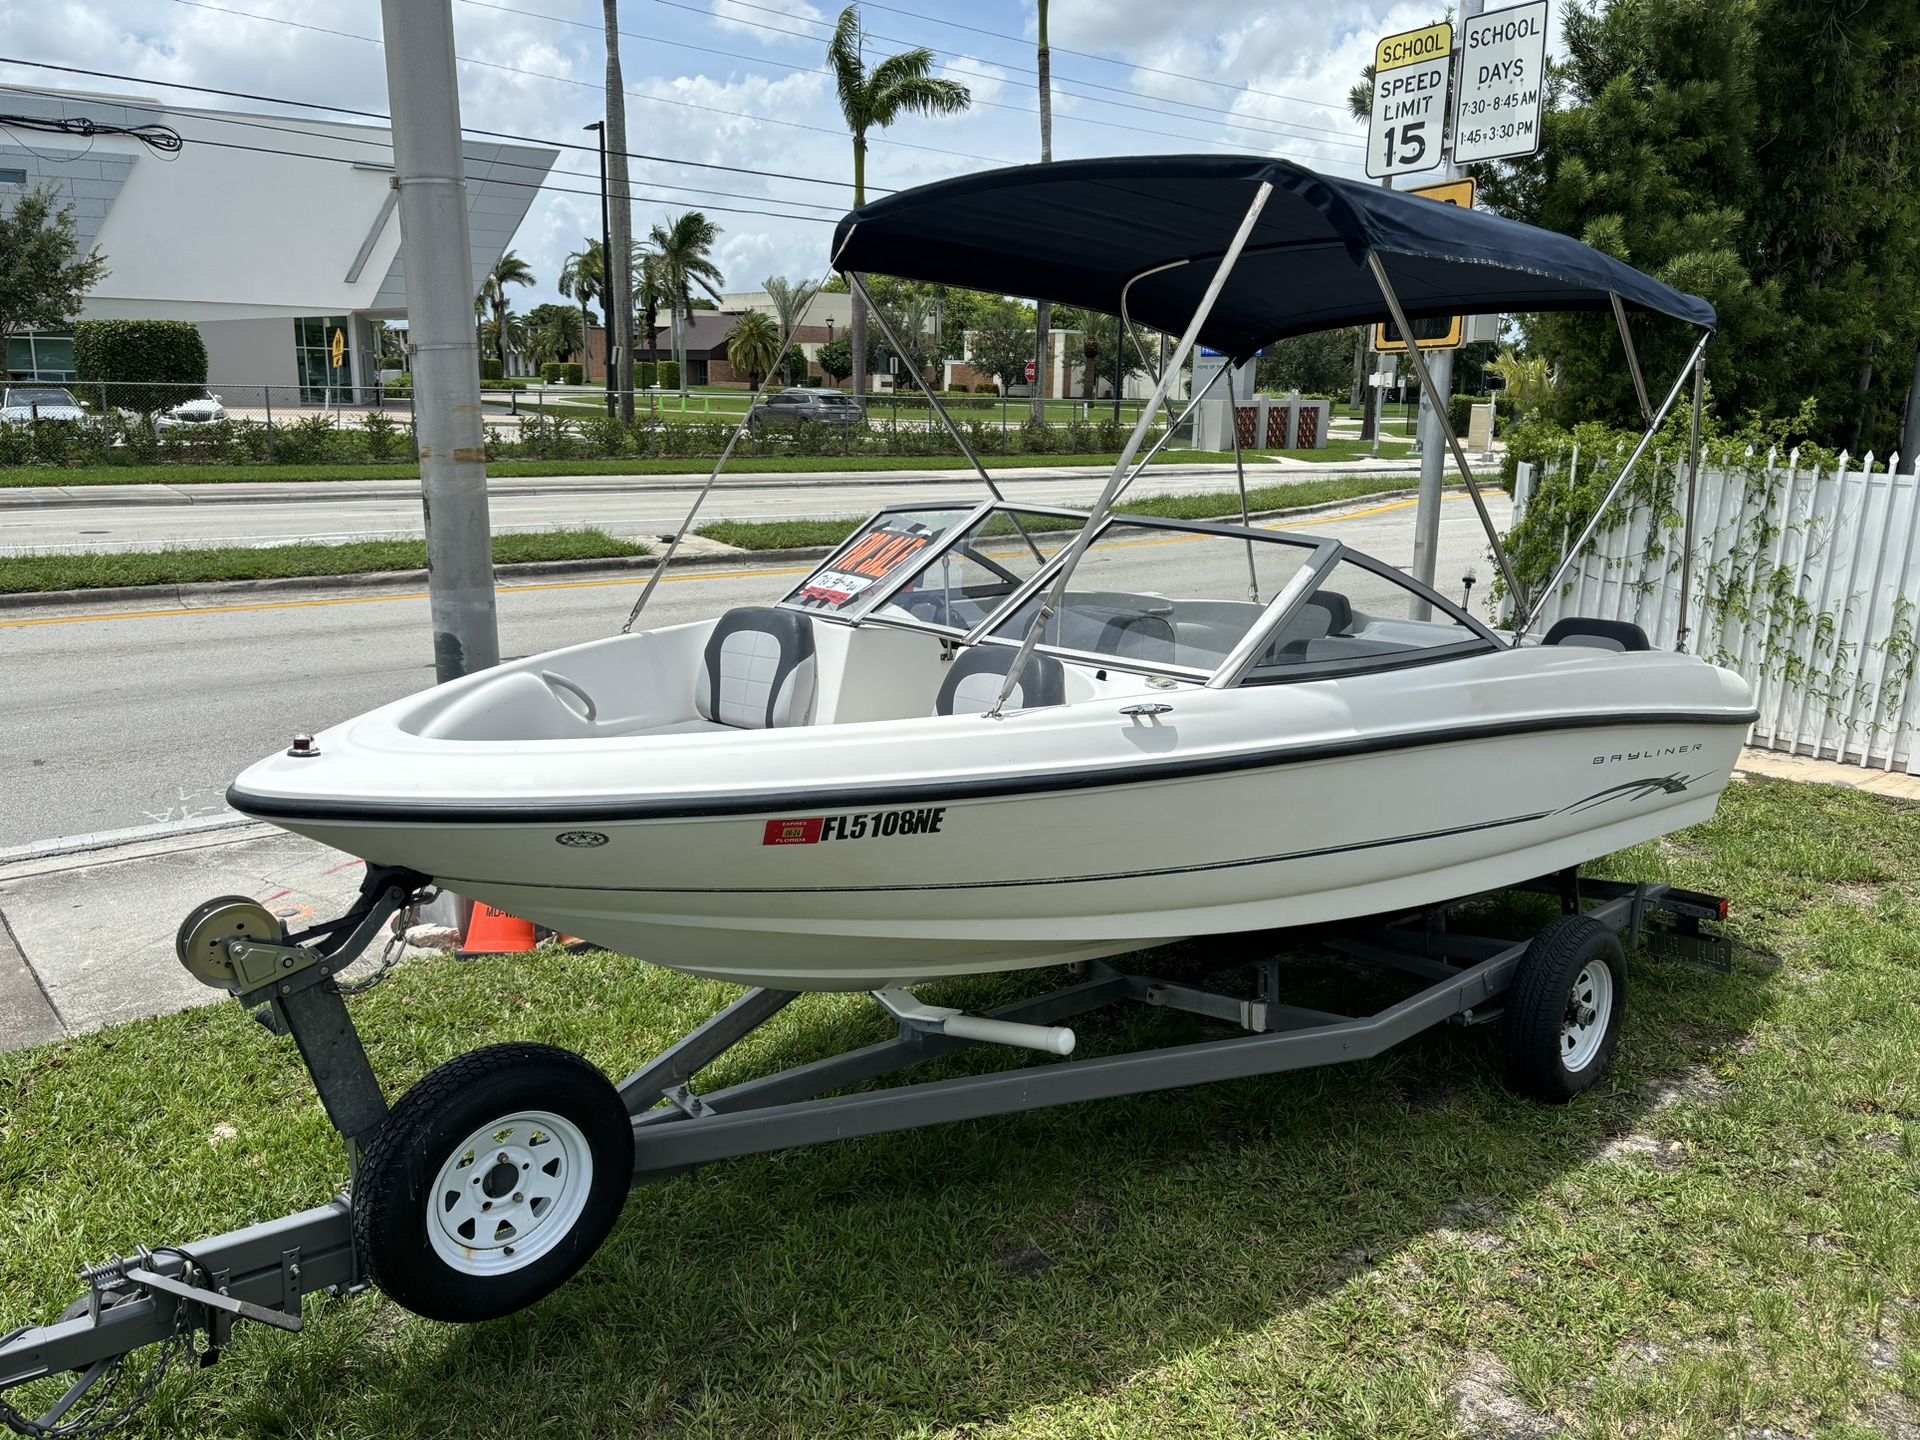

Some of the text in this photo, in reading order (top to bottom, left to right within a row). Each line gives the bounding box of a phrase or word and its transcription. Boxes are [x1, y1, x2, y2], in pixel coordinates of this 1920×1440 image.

[1469, 17, 1540, 49] SCHOOL
[1382, 33, 1444, 64] SCHOOL
[1478, 58, 1524, 84] DAYS
[1380, 70, 1442, 99] SPEED
[1520, 89, 1537, 106] AM
[1383, 95, 1433, 121] LIMIT
[1516, 120, 1533, 136] PM
[1384, 121, 1426, 168] 15
[1592, 743, 1703, 765] BAYLINER
